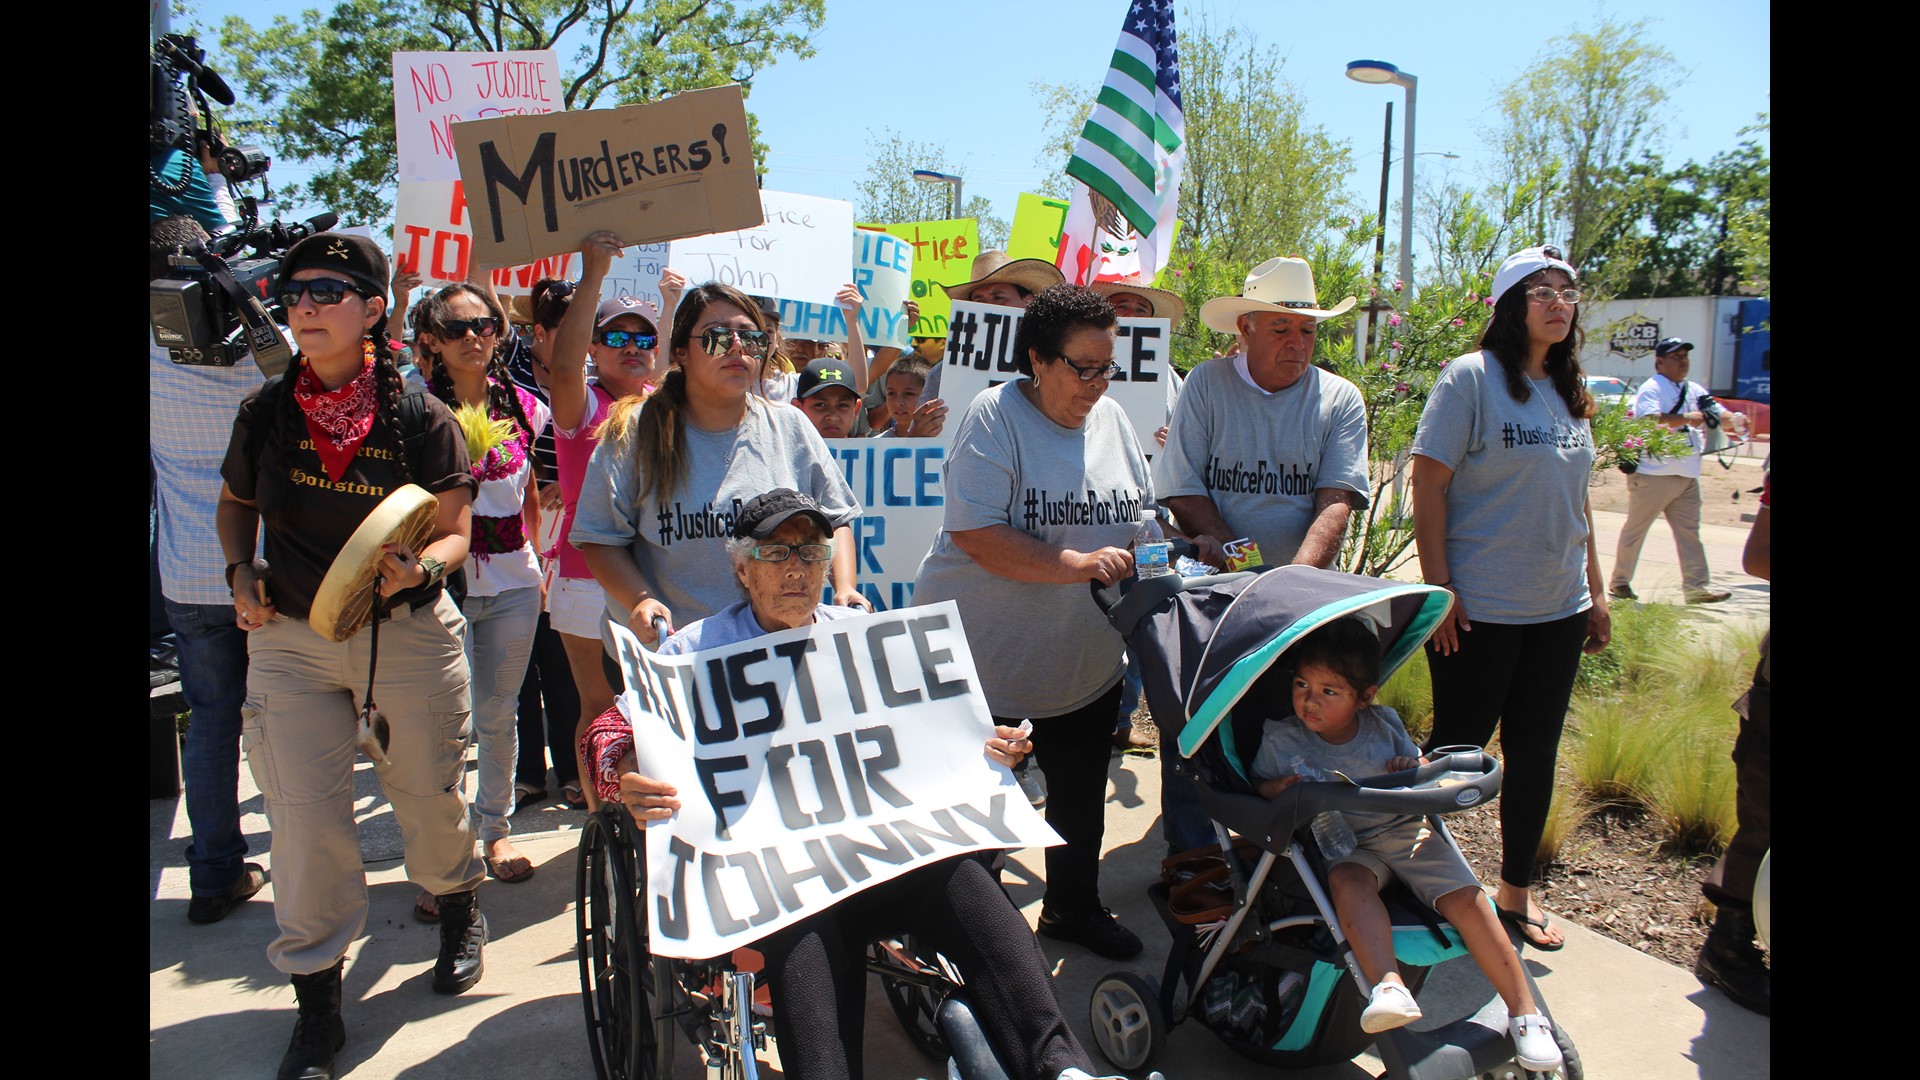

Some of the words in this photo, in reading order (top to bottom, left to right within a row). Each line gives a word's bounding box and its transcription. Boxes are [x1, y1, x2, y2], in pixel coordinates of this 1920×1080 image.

[410, 63, 452, 113] NO
[471, 59, 551, 102] JUSTICE
[764, 203, 816, 229] tice
[685, 252, 780, 296] John
[911, 278, 939, 298] or
[288, 468, 385, 497] Houston
[840, 447, 944, 507] TICE
[621, 613, 973, 747] #JUSTICE
[693, 724, 914, 842] FOR
[655, 793, 1023, 942] JOHNNY
